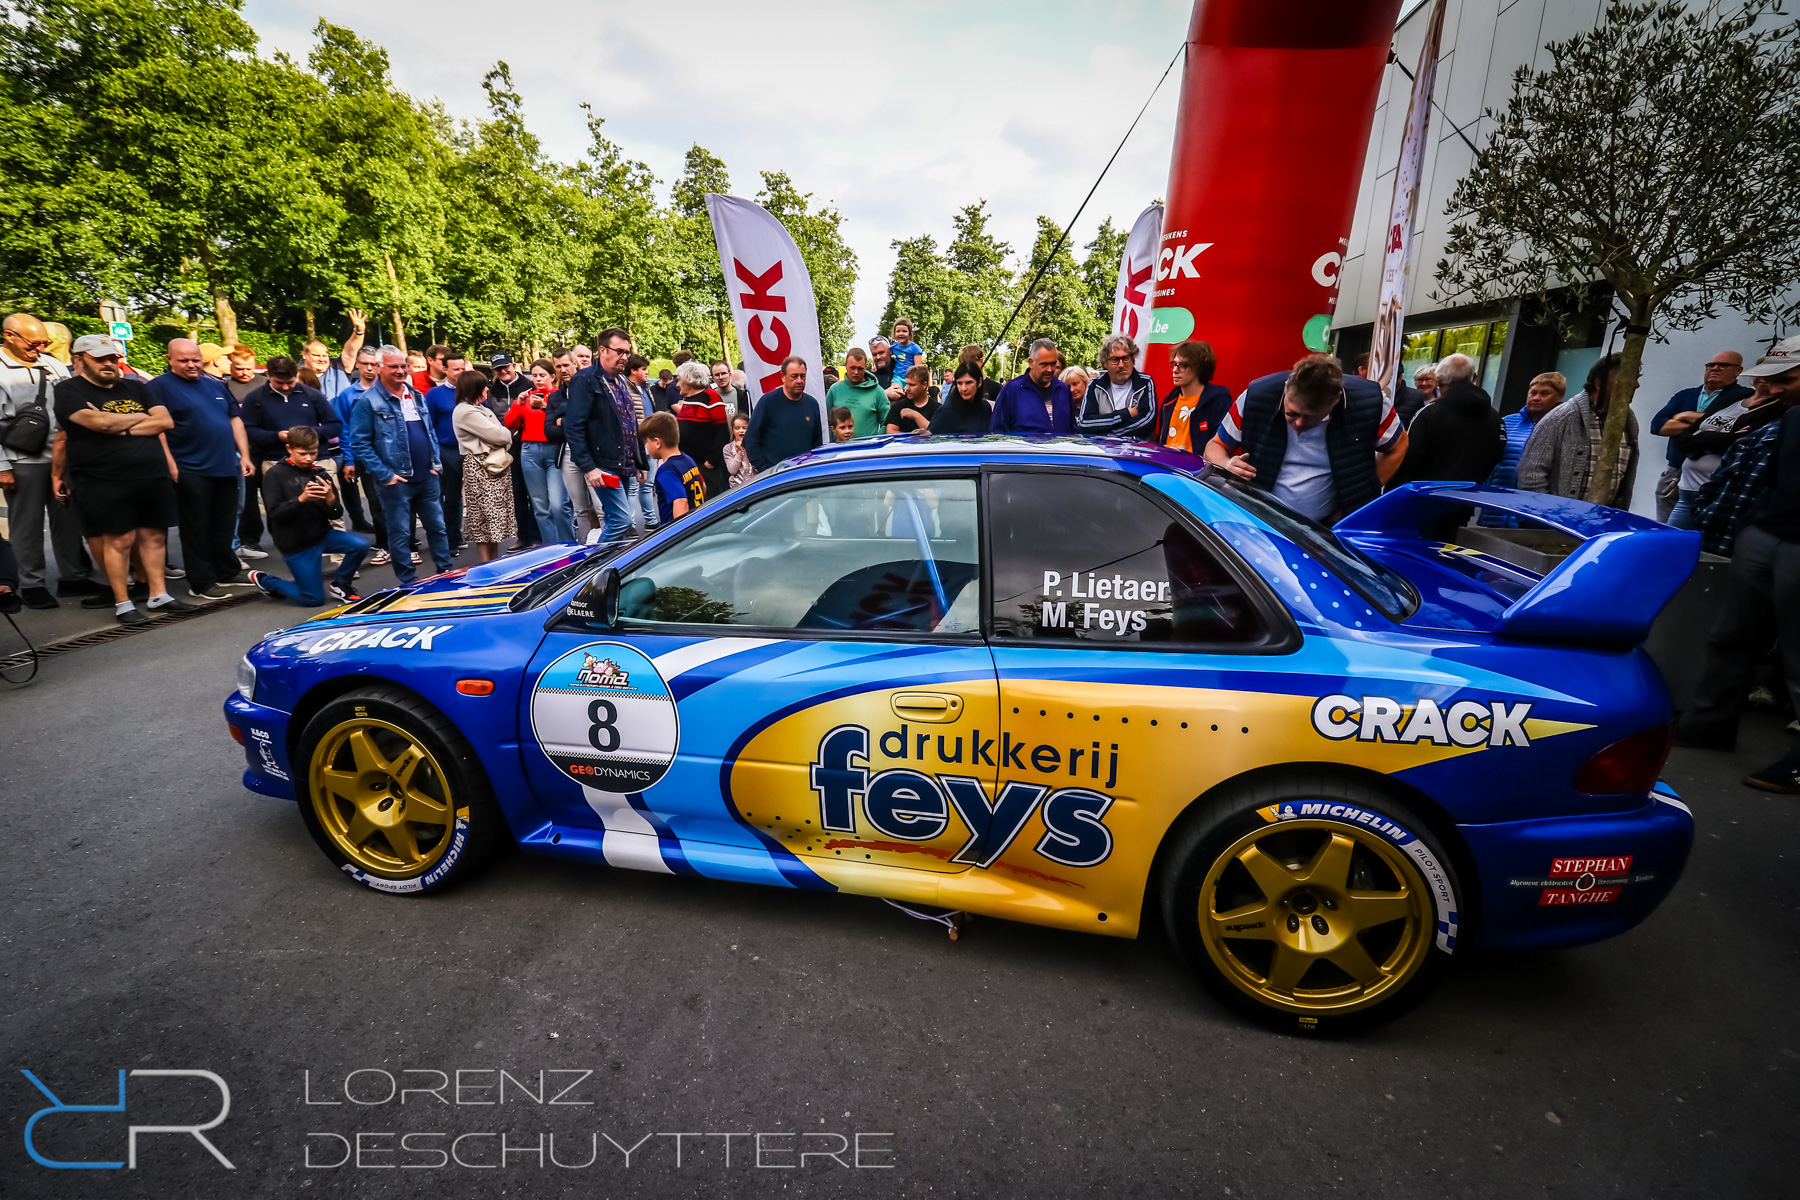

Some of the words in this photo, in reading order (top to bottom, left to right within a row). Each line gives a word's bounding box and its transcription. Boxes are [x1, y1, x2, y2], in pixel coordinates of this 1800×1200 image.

[1155, 243, 1215, 283] CK
[733, 257, 792, 394] CK
[1043, 570, 1062, 597] P.
[1071, 571, 1170, 601] Lietaer
[1042, 602, 1074, 628] M.
[1083, 603, 1147, 636] Feys
[309, 625, 454, 655] CRACK
[587, 698, 621, 753] 8
[1310, 693, 1537, 748] CRACK
[570, 764, 651, 781] GEODYNAMICS
[879, 724, 1119, 789] drukkerij
[809, 723, 1117, 870] feys
[1300, 803, 1407, 840] MICHELIN
[424, 832, 465, 886] MICHELIN
[1415, 848, 1437, 871] PILOT
[1433, 873, 1450, 903] SPORT
[1552, 857, 1629, 874] STEPHAN
[1547, 891, 1612, 905] TANGHE
